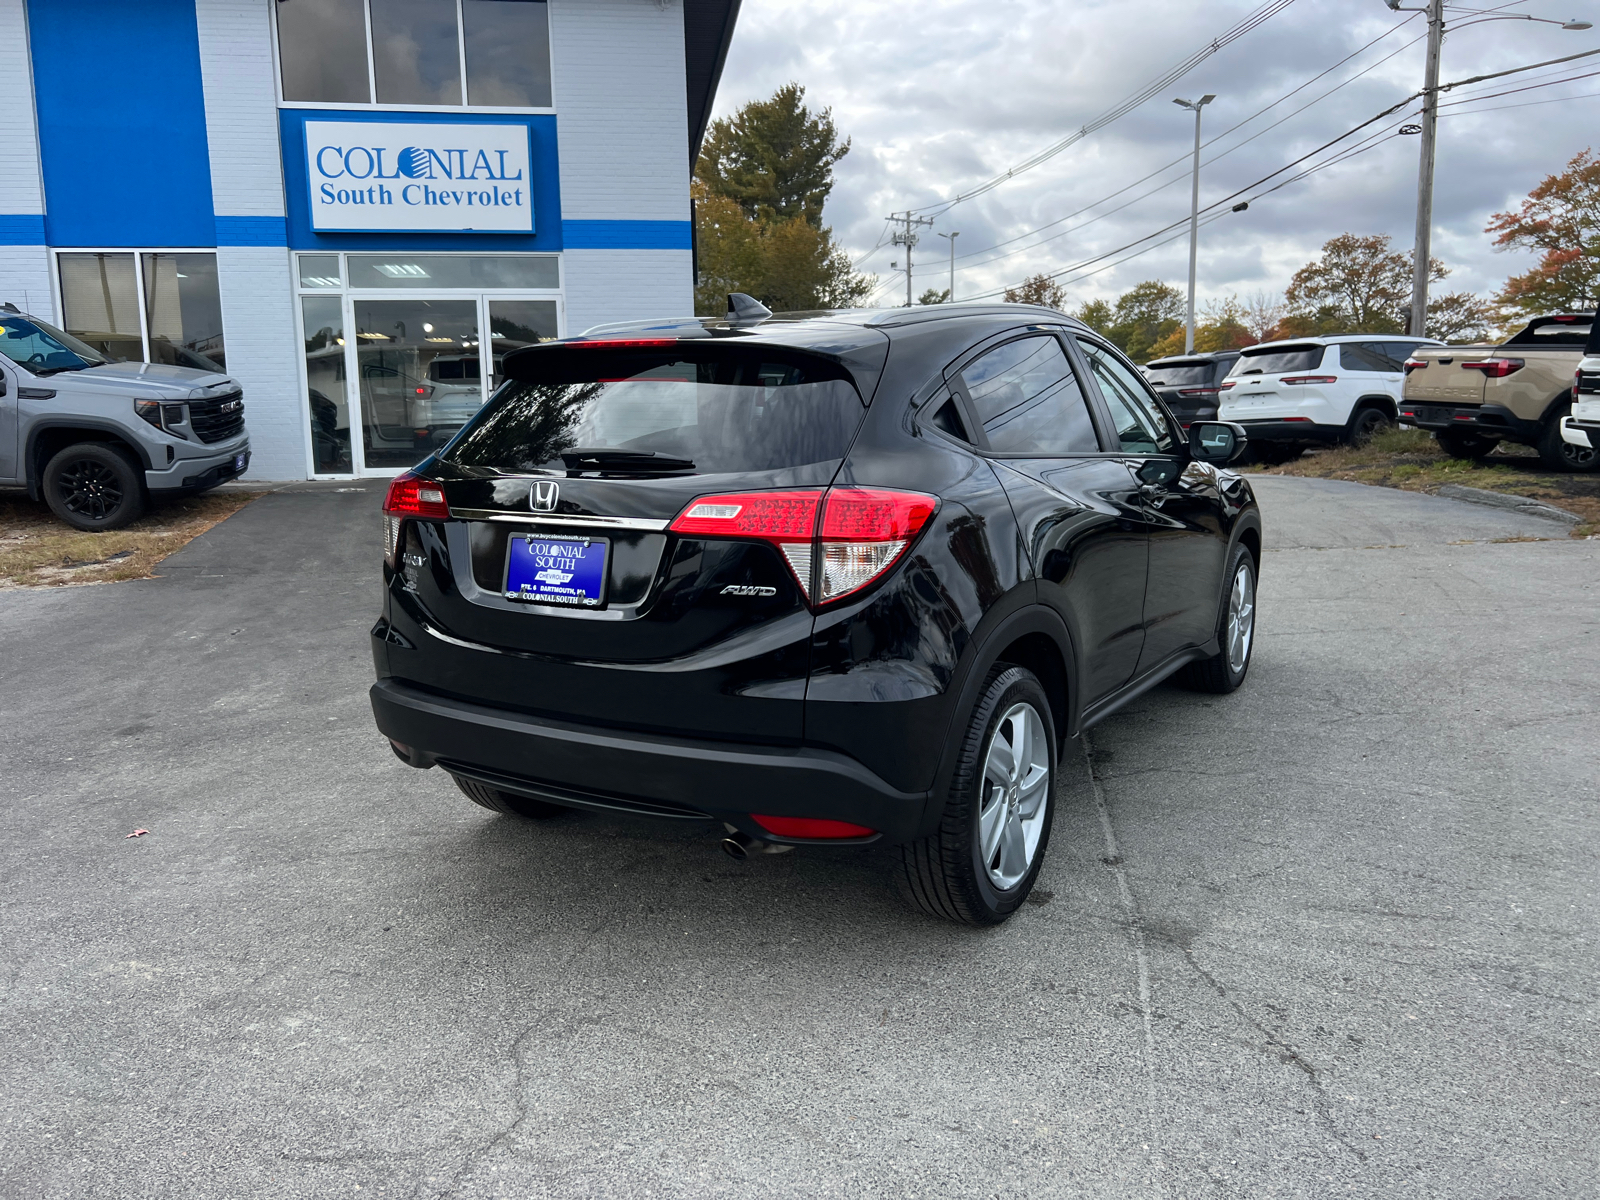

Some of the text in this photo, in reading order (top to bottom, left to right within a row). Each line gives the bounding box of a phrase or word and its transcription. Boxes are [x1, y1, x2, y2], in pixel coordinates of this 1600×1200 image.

[316, 145, 523, 181] COLONIAL
[320, 182, 524, 207] South Chevrolet
[528, 543, 586, 559] COLONIAL
[535, 556, 576, 570] SOUTH
[538, 572, 570, 581] CHEVROLET
[719, 584, 777, 597] AWD
[522, 592, 578, 604] COLONIAL SOUTH
